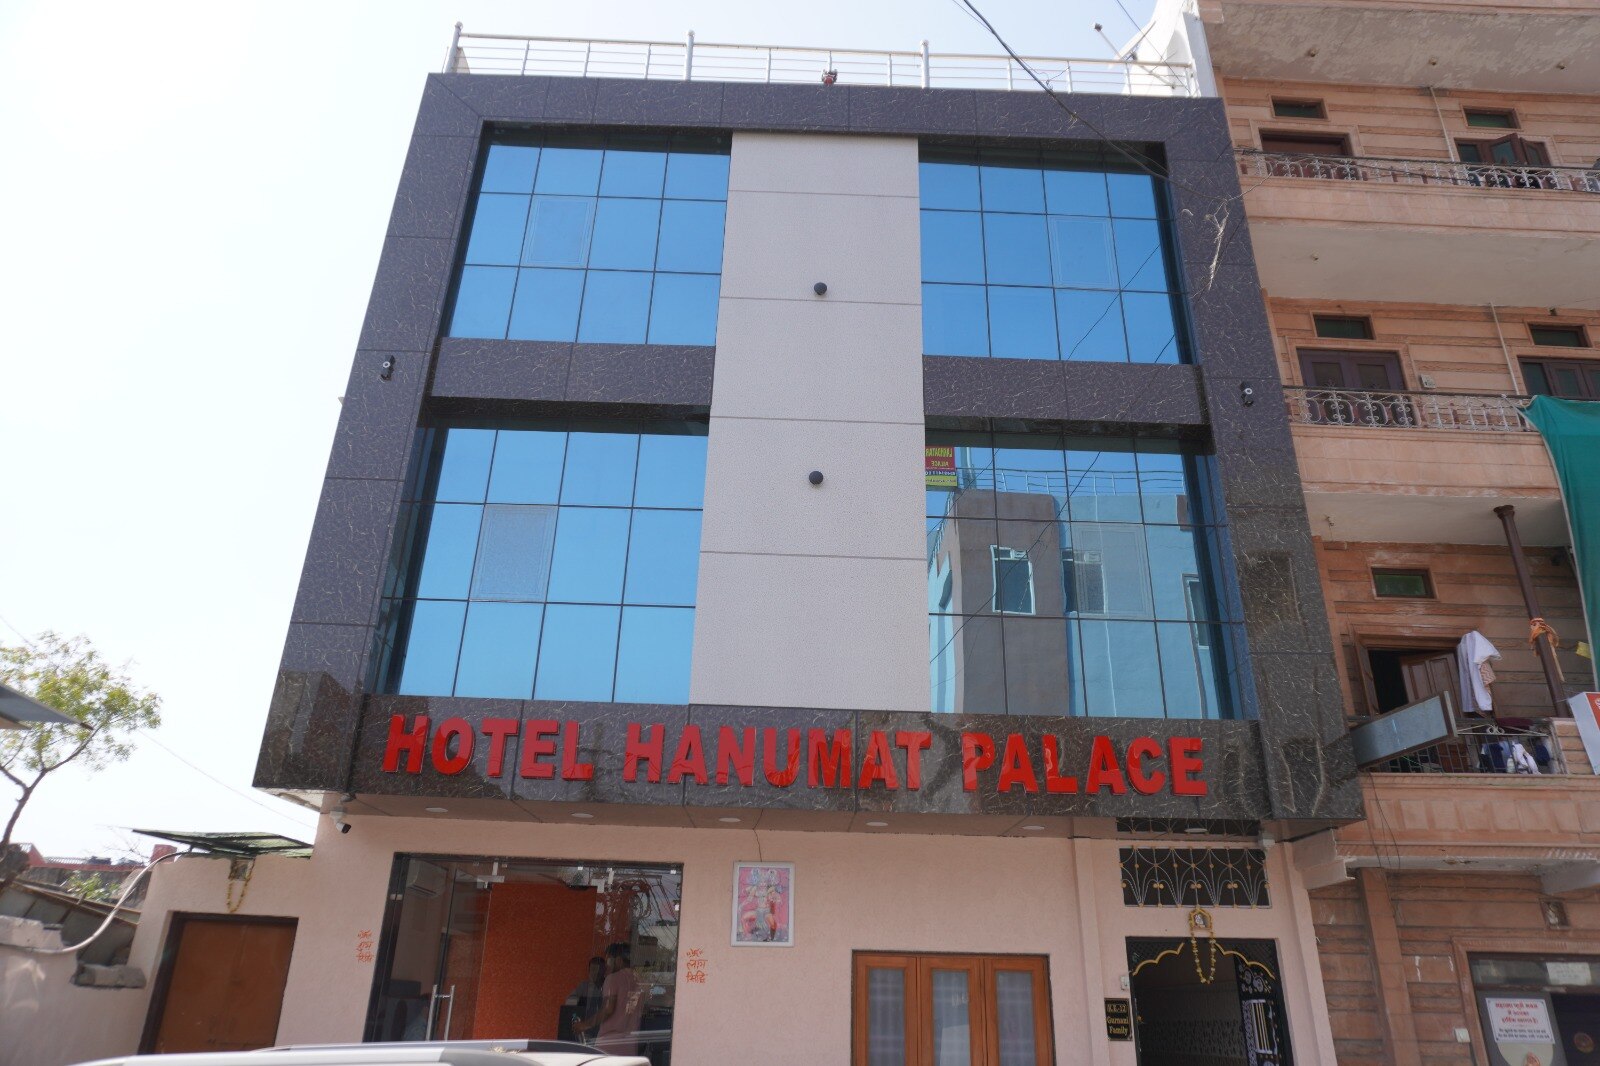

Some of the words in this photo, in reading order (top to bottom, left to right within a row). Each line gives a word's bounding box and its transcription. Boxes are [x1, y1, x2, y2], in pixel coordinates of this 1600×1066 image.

[382, 714, 596, 782] HOTEL
[623, 722, 932, 791] HANUMAT
[962, 732, 1209, 797] PALACE
[1109, 1026, 1128, 1036] Family
